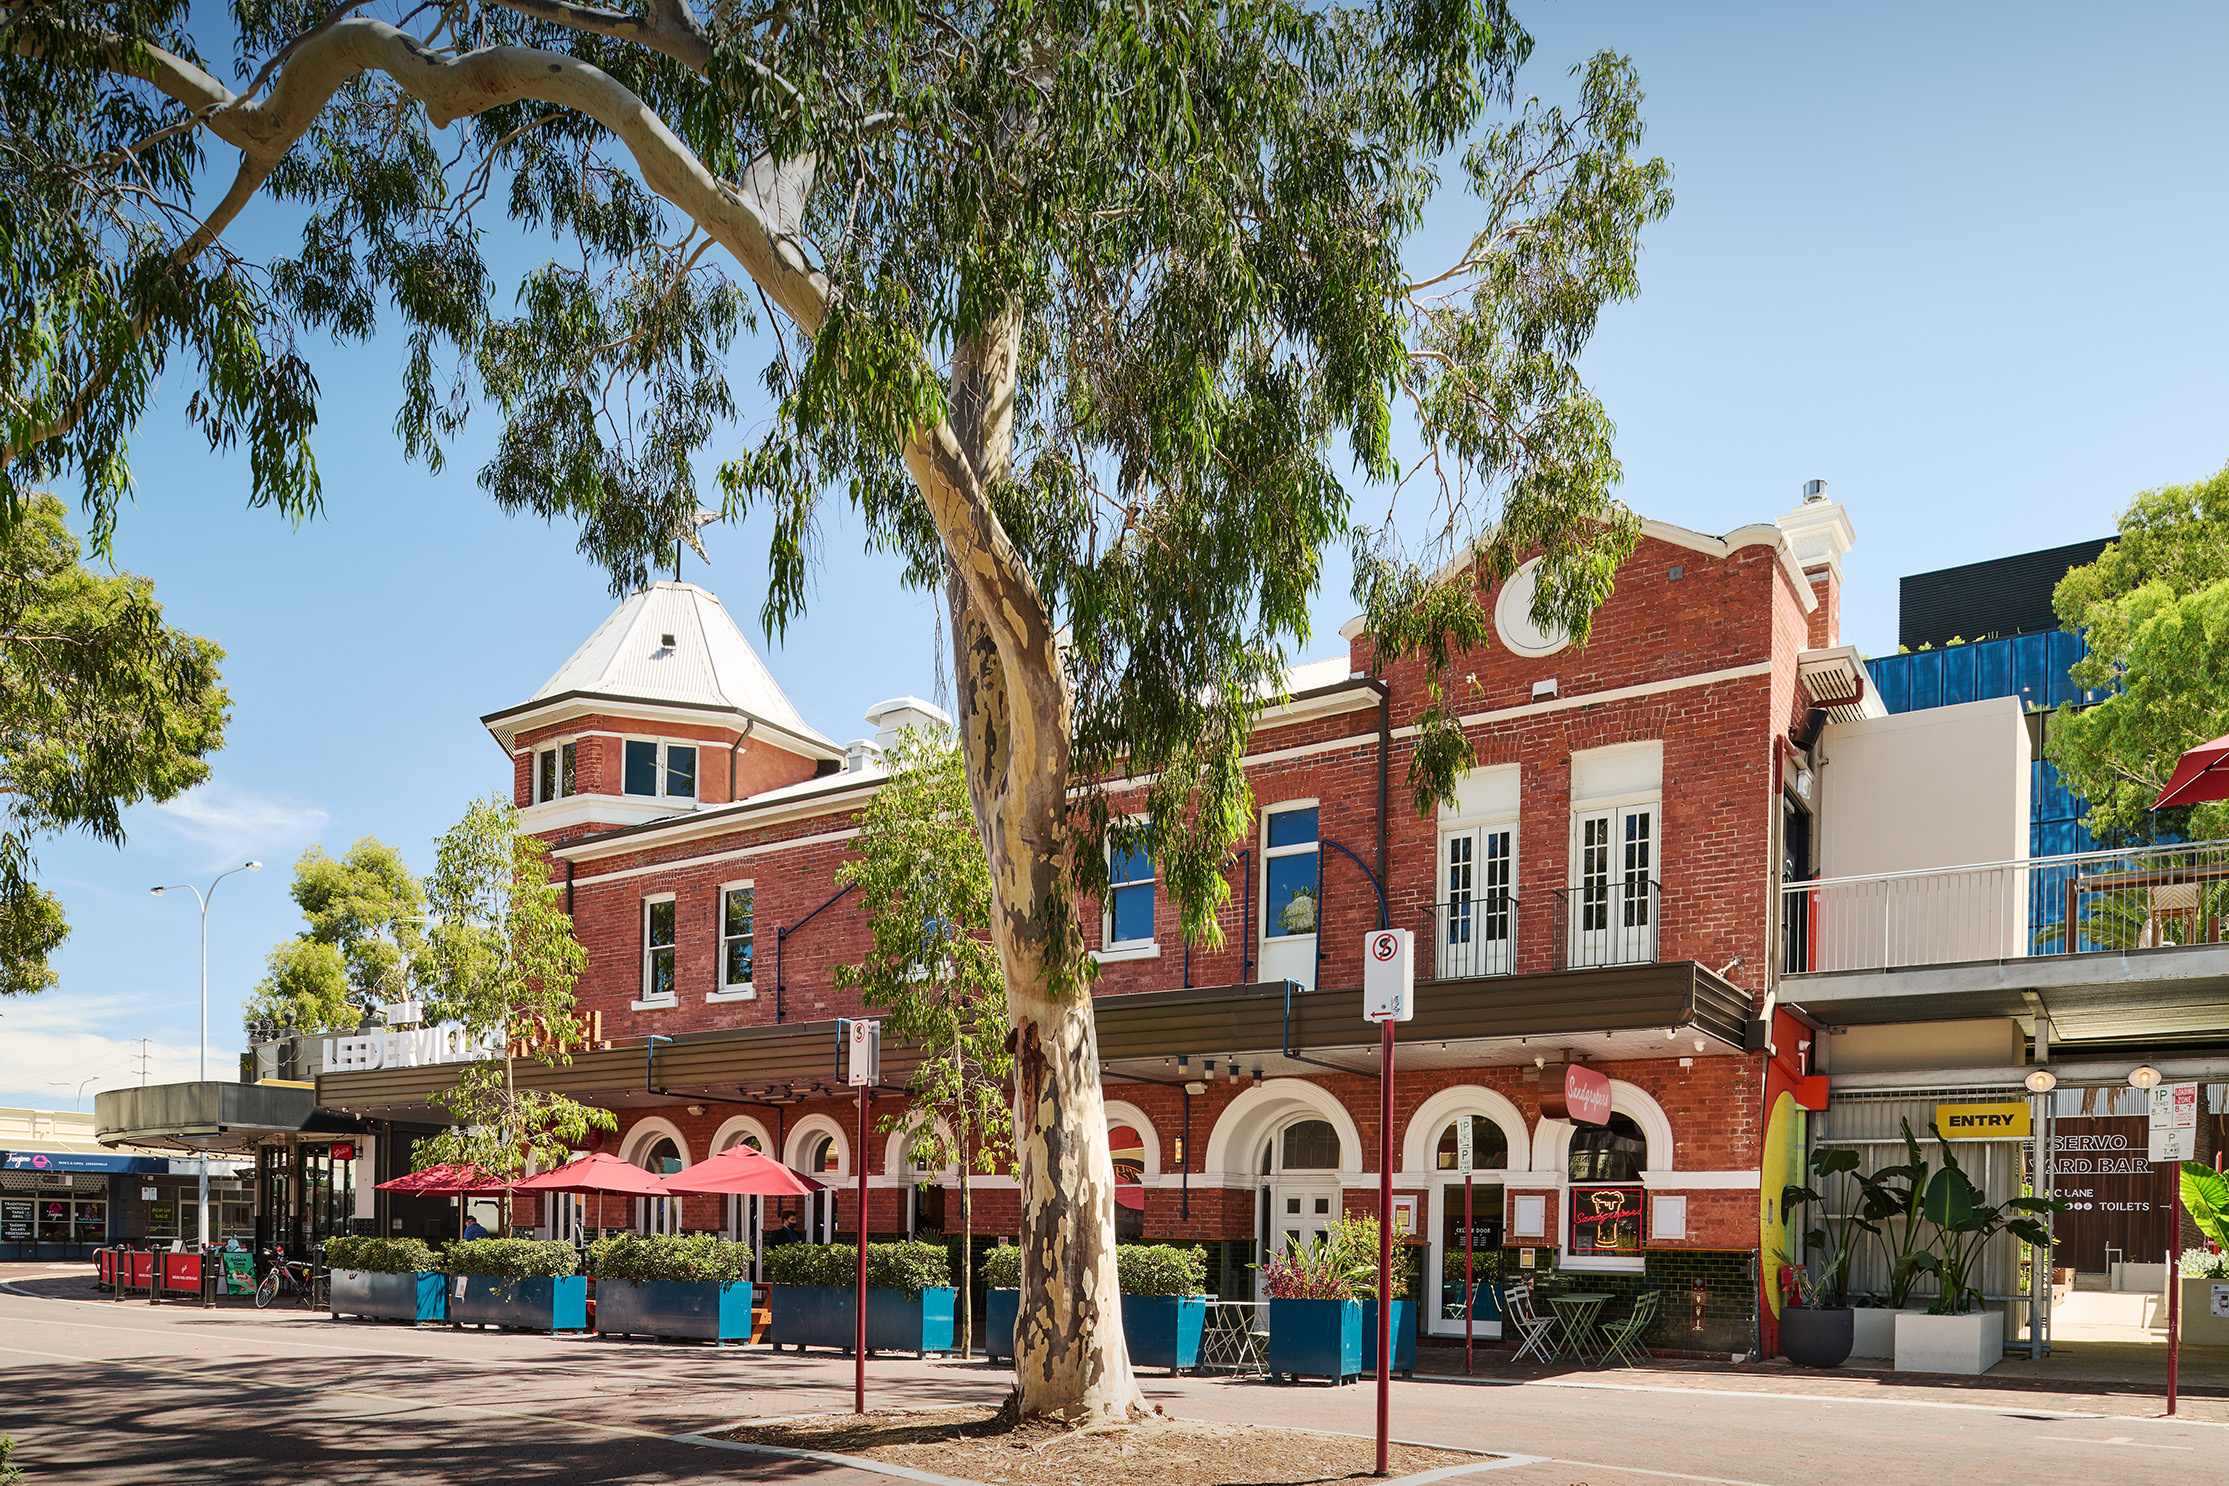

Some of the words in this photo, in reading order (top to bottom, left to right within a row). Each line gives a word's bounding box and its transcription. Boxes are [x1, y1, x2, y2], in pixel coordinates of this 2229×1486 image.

[385, 1001, 423, 1025] THE
[1567, 1075, 1609, 1112] Sandgropers
[2155, 1089, 2168, 1101] 1P
[2175, 1088, 2195, 1096] LOADING
[2177, 1095, 2192, 1104] ZONE
[1949, 1114, 2015, 1127] ENTRY
[1459, 1121, 1470, 1132] 1P
[2049, 1134, 2128, 1151] SERVO
[2168, 1133, 2176, 1142] P
[1462, 1149, 1469, 1160] P
[2097, 1157, 2149, 1174] BAR
[2064, 1188, 2094, 1198] LANE
[2099, 1202, 2150, 1211] TOILETS
[1574, 1208, 1642, 1225] Sandgropers
